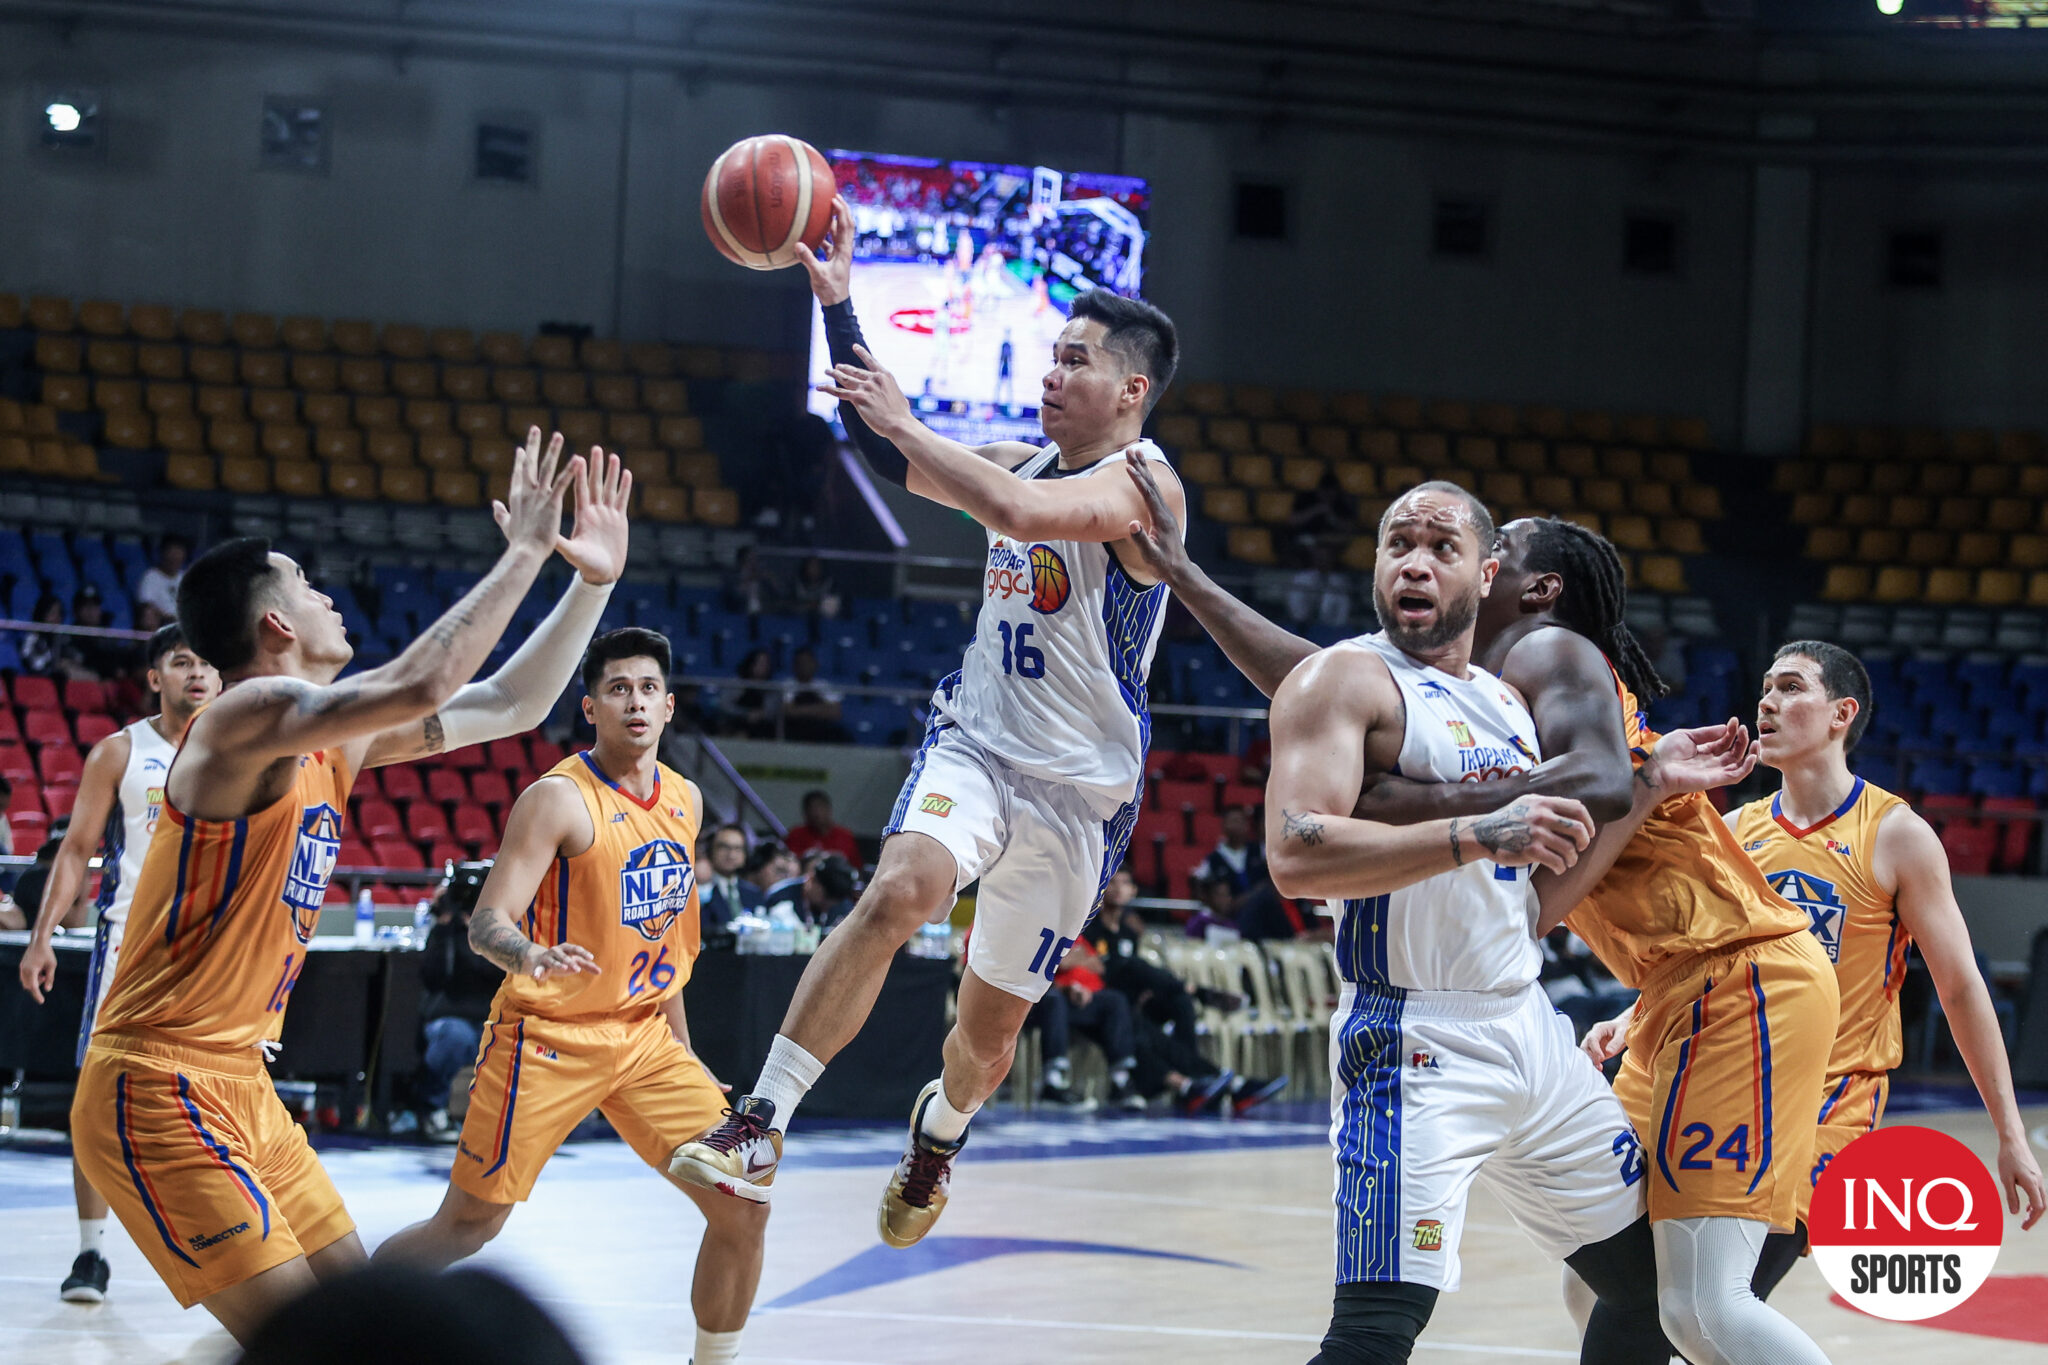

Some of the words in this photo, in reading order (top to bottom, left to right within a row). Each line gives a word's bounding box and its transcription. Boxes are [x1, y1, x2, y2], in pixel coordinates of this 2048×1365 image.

[989, 548, 1026, 571] TROPA
[997, 620, 1046, 680] 16
[919, 796, 958, 814] TNT
[624, 866, 692, 905] NLEX
[623, 904, 650, 921] ROAD
[628, 944, 676, 996] 26
[1678, 1121, 1750, 1173] 24
[1412, 1223, 1445, 1248] TNT
